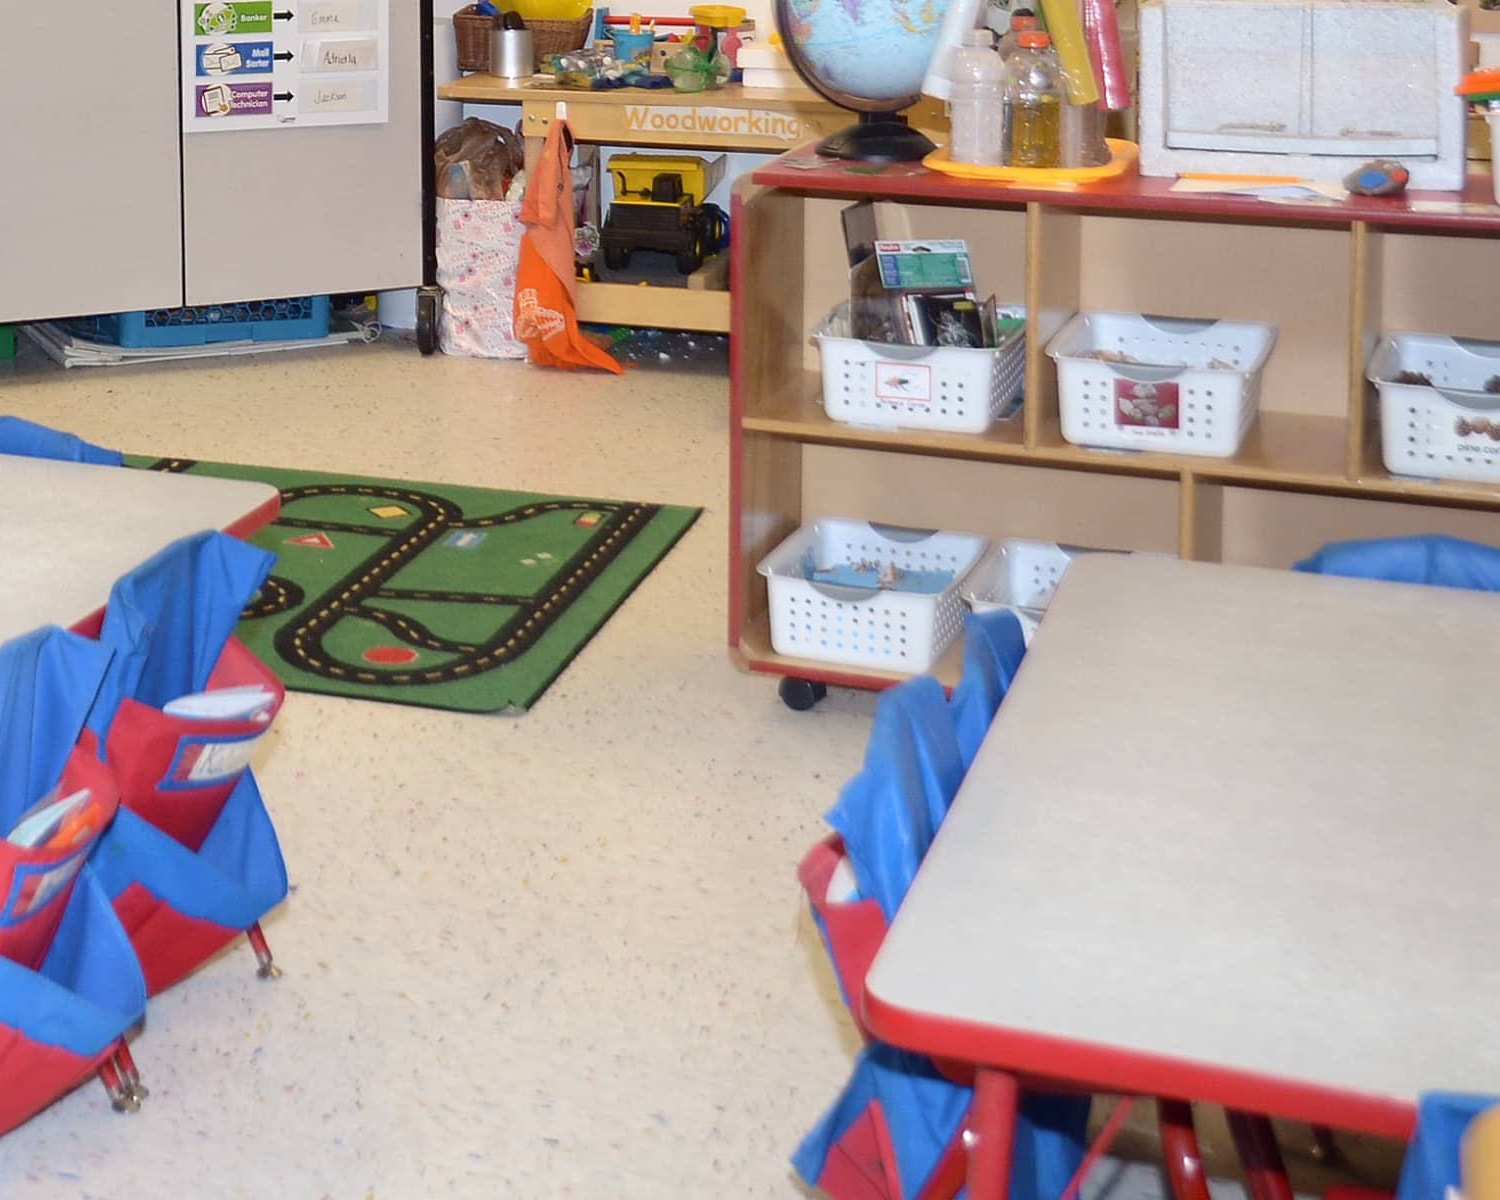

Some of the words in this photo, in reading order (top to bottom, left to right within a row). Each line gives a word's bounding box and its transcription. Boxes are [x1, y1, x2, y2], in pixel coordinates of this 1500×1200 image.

[240, 14, 268, 22] Banker
[251, 47, 270, 57] Mail
[245, 59, 270, 69] Sorter
[231, 90, 268, 100] Computer
[228, 100, 269, 109] Technician
[624, 105, 803, 141] Woodworking
